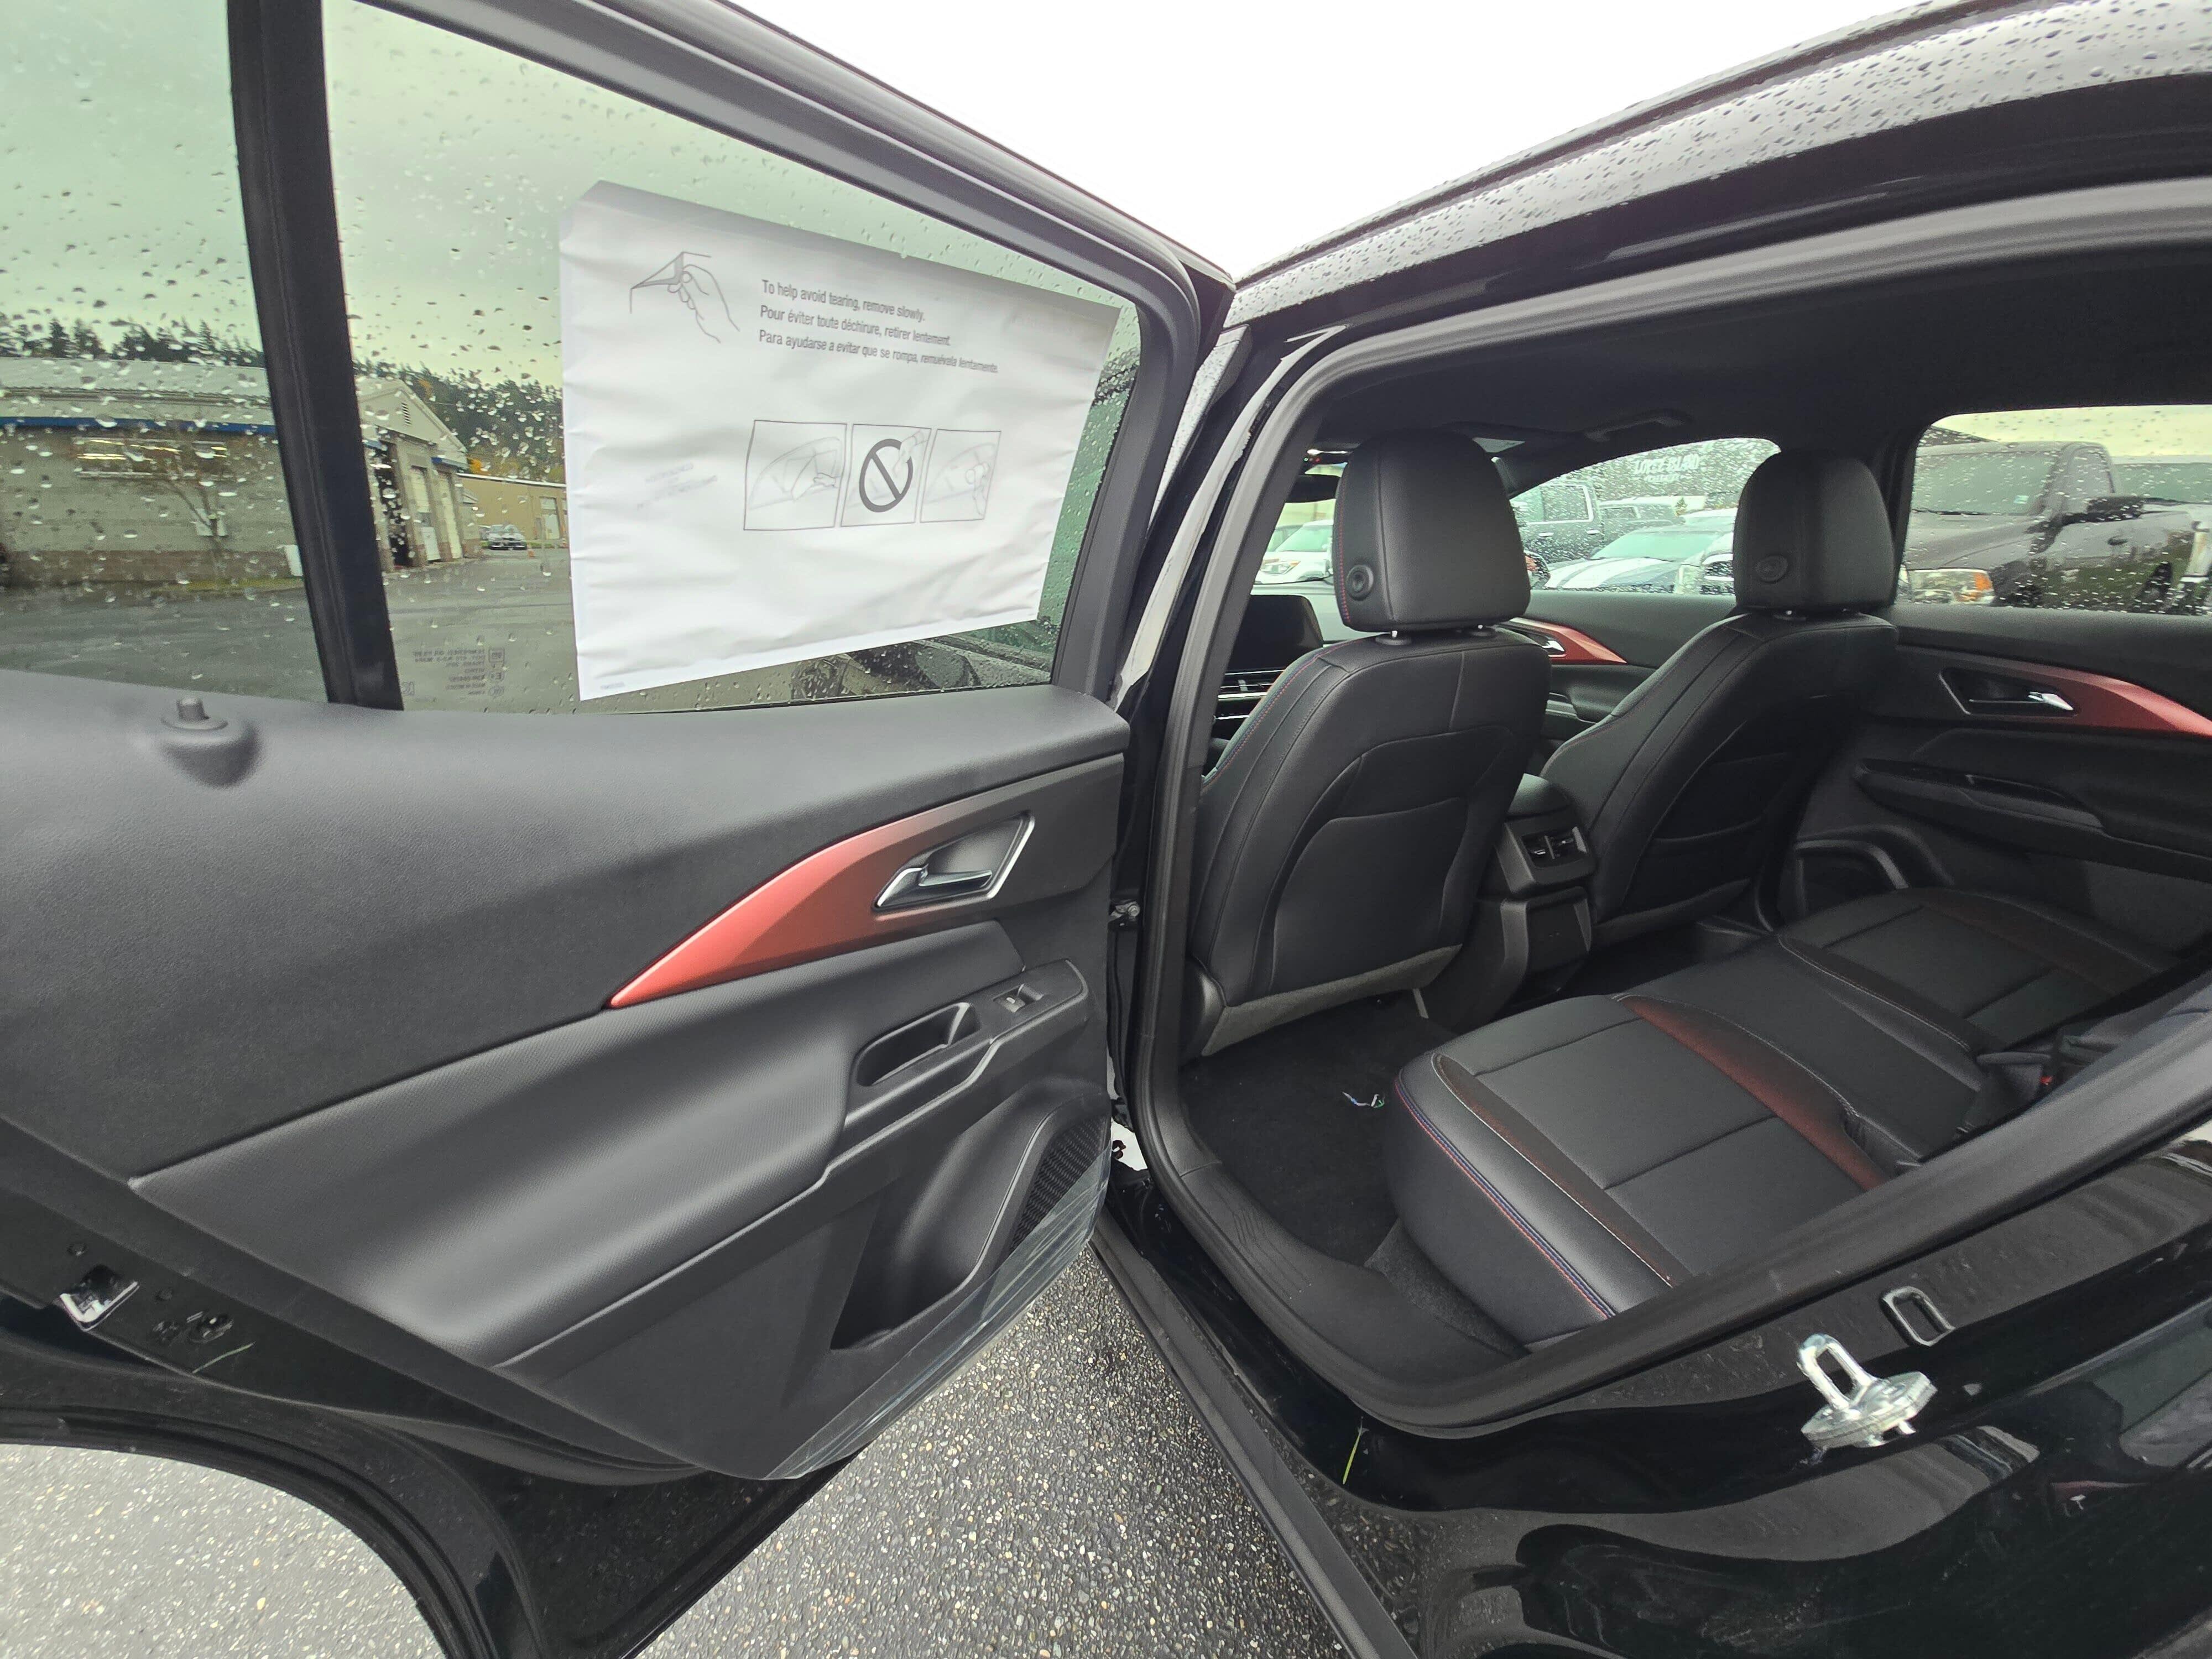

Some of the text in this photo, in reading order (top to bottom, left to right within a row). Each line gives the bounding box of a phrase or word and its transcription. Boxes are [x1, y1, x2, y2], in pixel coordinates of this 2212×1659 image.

[761, 279, 925, 323] To help avoid tearing, remove slowly.
[760, 305, 785, 321] Pour
[787, 309, 815, 326] éviter
[817, 315, 838, 330] toute
[841, 318, 881, 337] déchirure,
[884, 326, 910, 340] retirer
[759, 329, 782, 345] Para
[786, 336, 827, 349] ayudarse
[828, 342, 834, 351] a
[837, 342, 860, 354] evitar
[862, 346, 878, 357] que
[880, 348, 890, 359] se
[893, 351, 919, 364] rompa,
